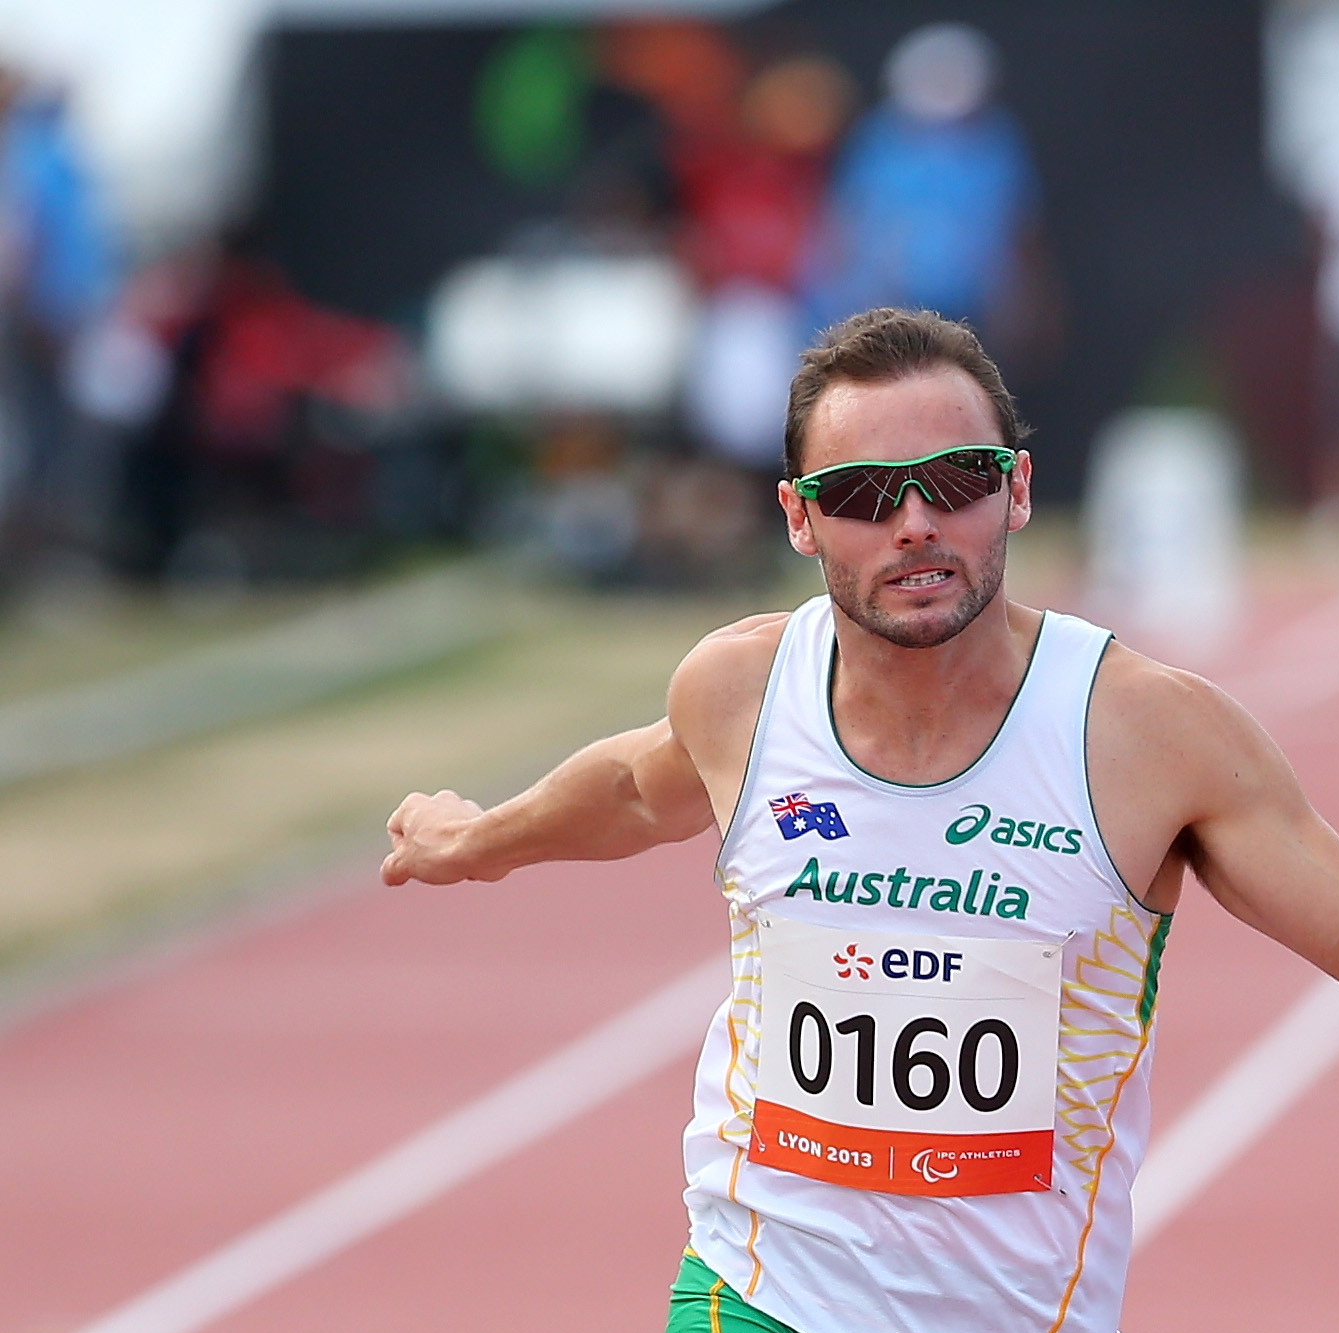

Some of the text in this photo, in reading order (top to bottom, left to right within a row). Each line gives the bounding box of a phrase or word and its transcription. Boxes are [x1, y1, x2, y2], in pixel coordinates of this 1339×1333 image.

[990, 818, 1083, 854] asics
[784, 857, 1031, 921] Australia
[881, 948, 963, 982] eDF
[788, 1000, 1019, 1113] 0160
[778, 1130, 873, 1168] LYON 2013
[936, 1147, 1021, 1161] IPC ATHLETICS
